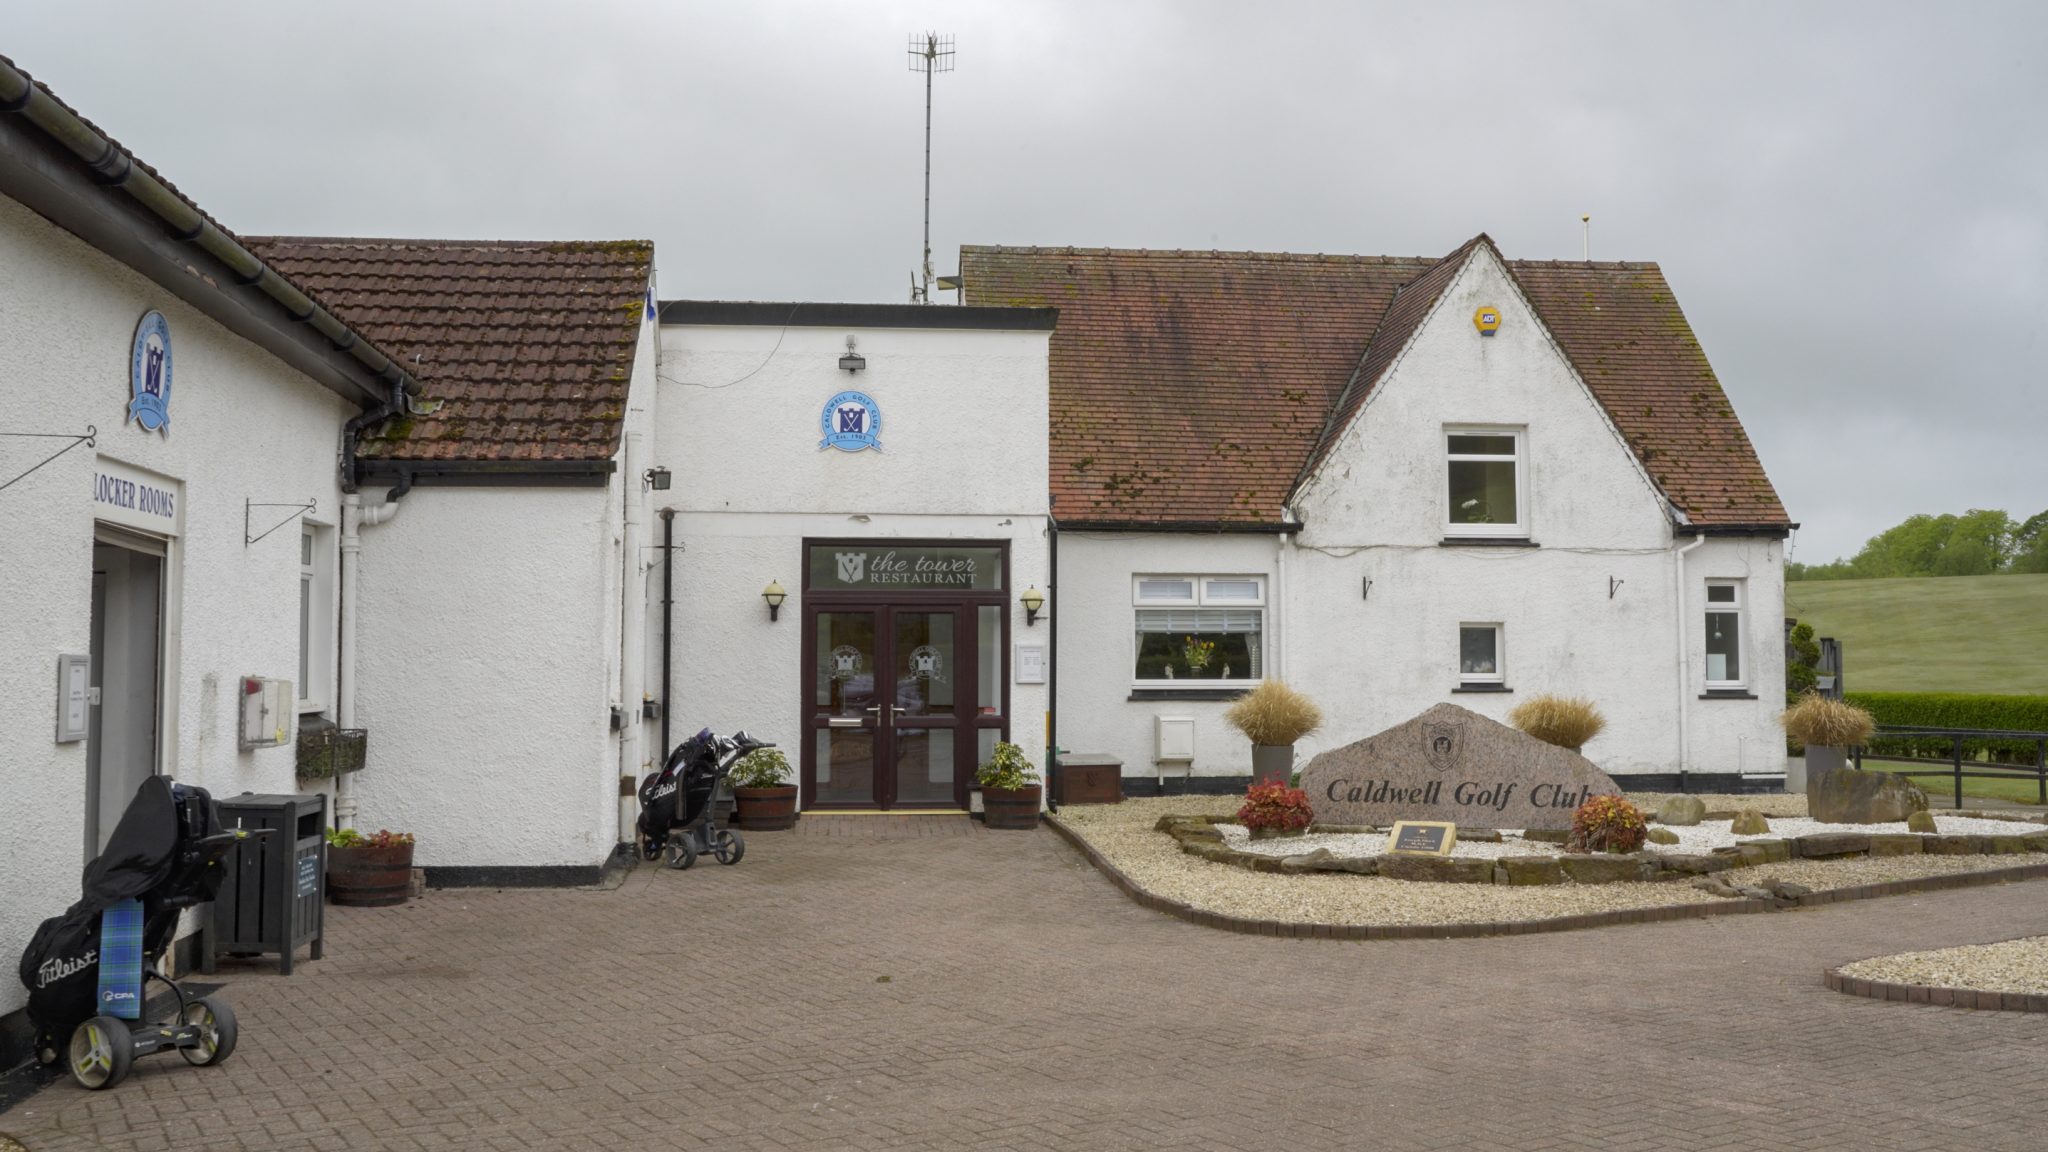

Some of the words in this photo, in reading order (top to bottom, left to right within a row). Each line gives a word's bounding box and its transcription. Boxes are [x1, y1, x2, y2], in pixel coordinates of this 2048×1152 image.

[825, 395, 847, 429] CALDWELL
[852, 394, 871, 406] GOLF
[871, 409, 879, 429] CLUB
[94, 472, 136, 510] LOCKER
[139, 484, 174, 519] ROOMS
[870, 573, 977, 584] RESTAURANT
[871, 551, 909, 572] the
[915, 555, 977, 573] tower
[1326, 778, 1442, 806] Caldwell
[1454, 781, 1518, 812] Golf
[37, 950, 98, 988] Titleist
